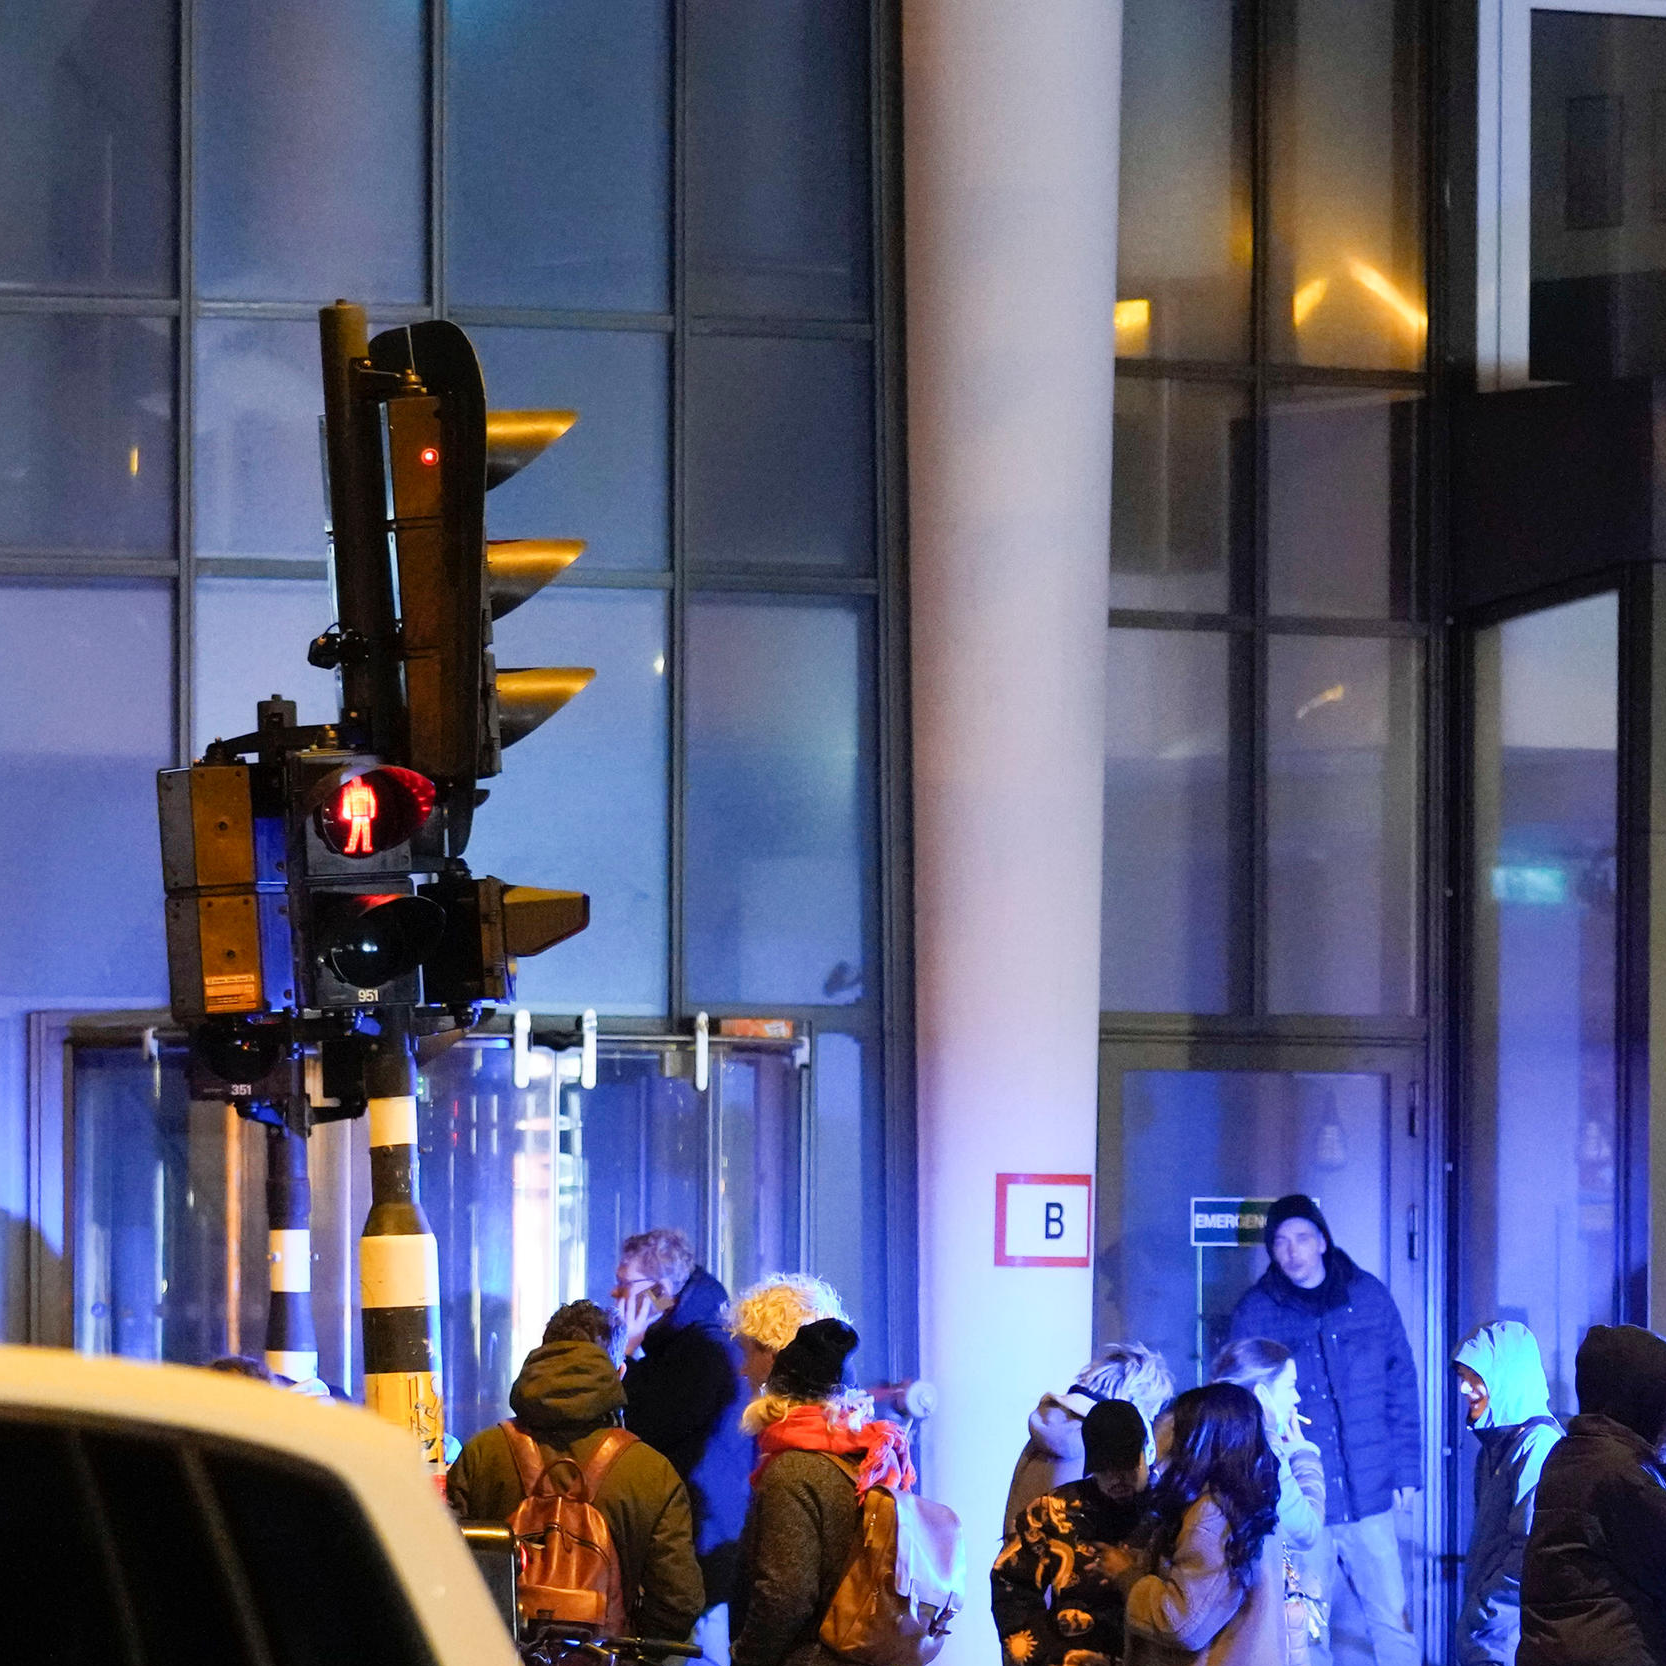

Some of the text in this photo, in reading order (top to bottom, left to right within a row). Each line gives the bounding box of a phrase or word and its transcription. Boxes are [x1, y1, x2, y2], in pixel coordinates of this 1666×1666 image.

[358, 989, 379, 1002] 951
[231, 1083, 252, 1096] 351
[1044, 1202, 1064, 1239] B
